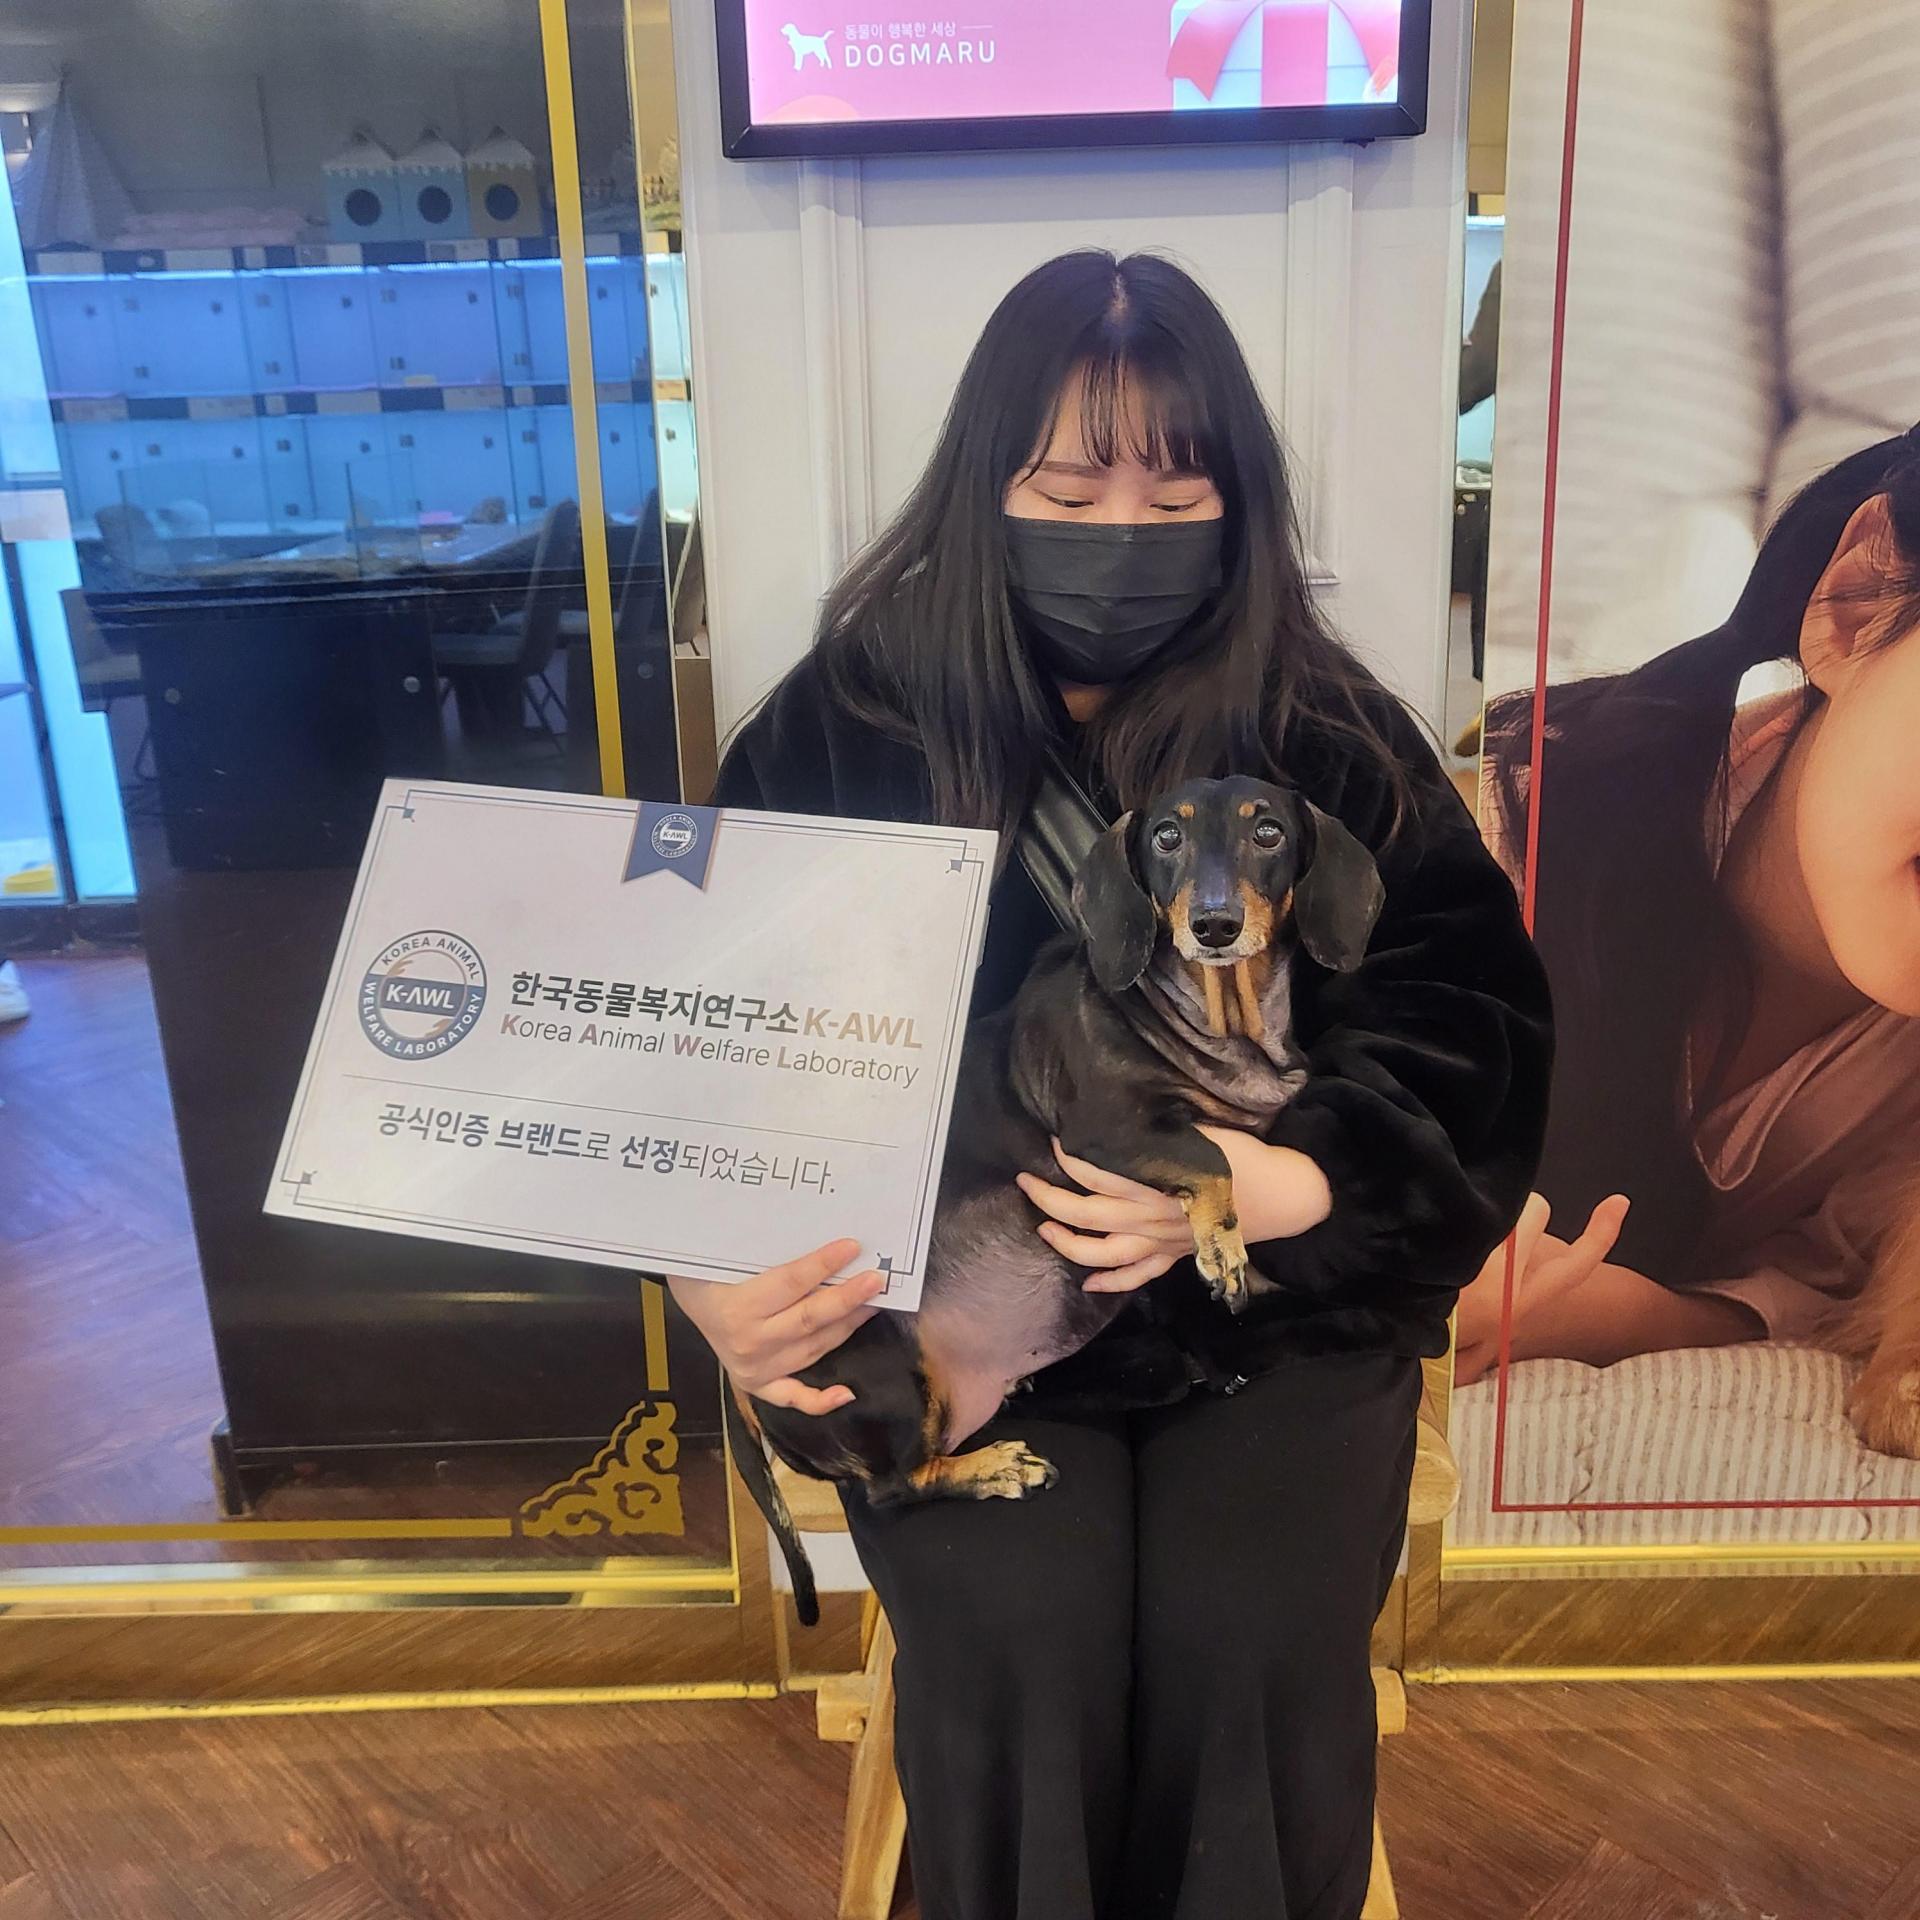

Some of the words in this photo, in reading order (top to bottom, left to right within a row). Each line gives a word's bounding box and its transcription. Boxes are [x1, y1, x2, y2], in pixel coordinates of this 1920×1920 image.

[845, 23, 883, 40] 동물이
[888, 21, 927, 39] 행복한
[931, 21, 956, 37] 세상
[845, 40, 996, 67] DOGMARU
[663, 830, 689, 840] K-AWL
[381, 936, 431, 966] KOREA
[436, 937, 481, 980] ANIMAL
[362, 981, 394, 1047] WELFARE
[394, 993, 483, 1055] LABORATORY
[386, 983, 455, 1010] K-AWL
[803, 1006, 923, 1049] K-AWL
[500, 1013, 572, 1043] Korea
[578, 1023, 666, 1054] Animal
[673, 1033, 770, 1067] Welfare
[776, 1045, 920, 1090] Laboratory
[378, 1102, 490, 1149] 공식인증
[494, 1119, 611, 1161] 브랜드로
[620, 1135, 836, 1195] 선정되었습니다.
